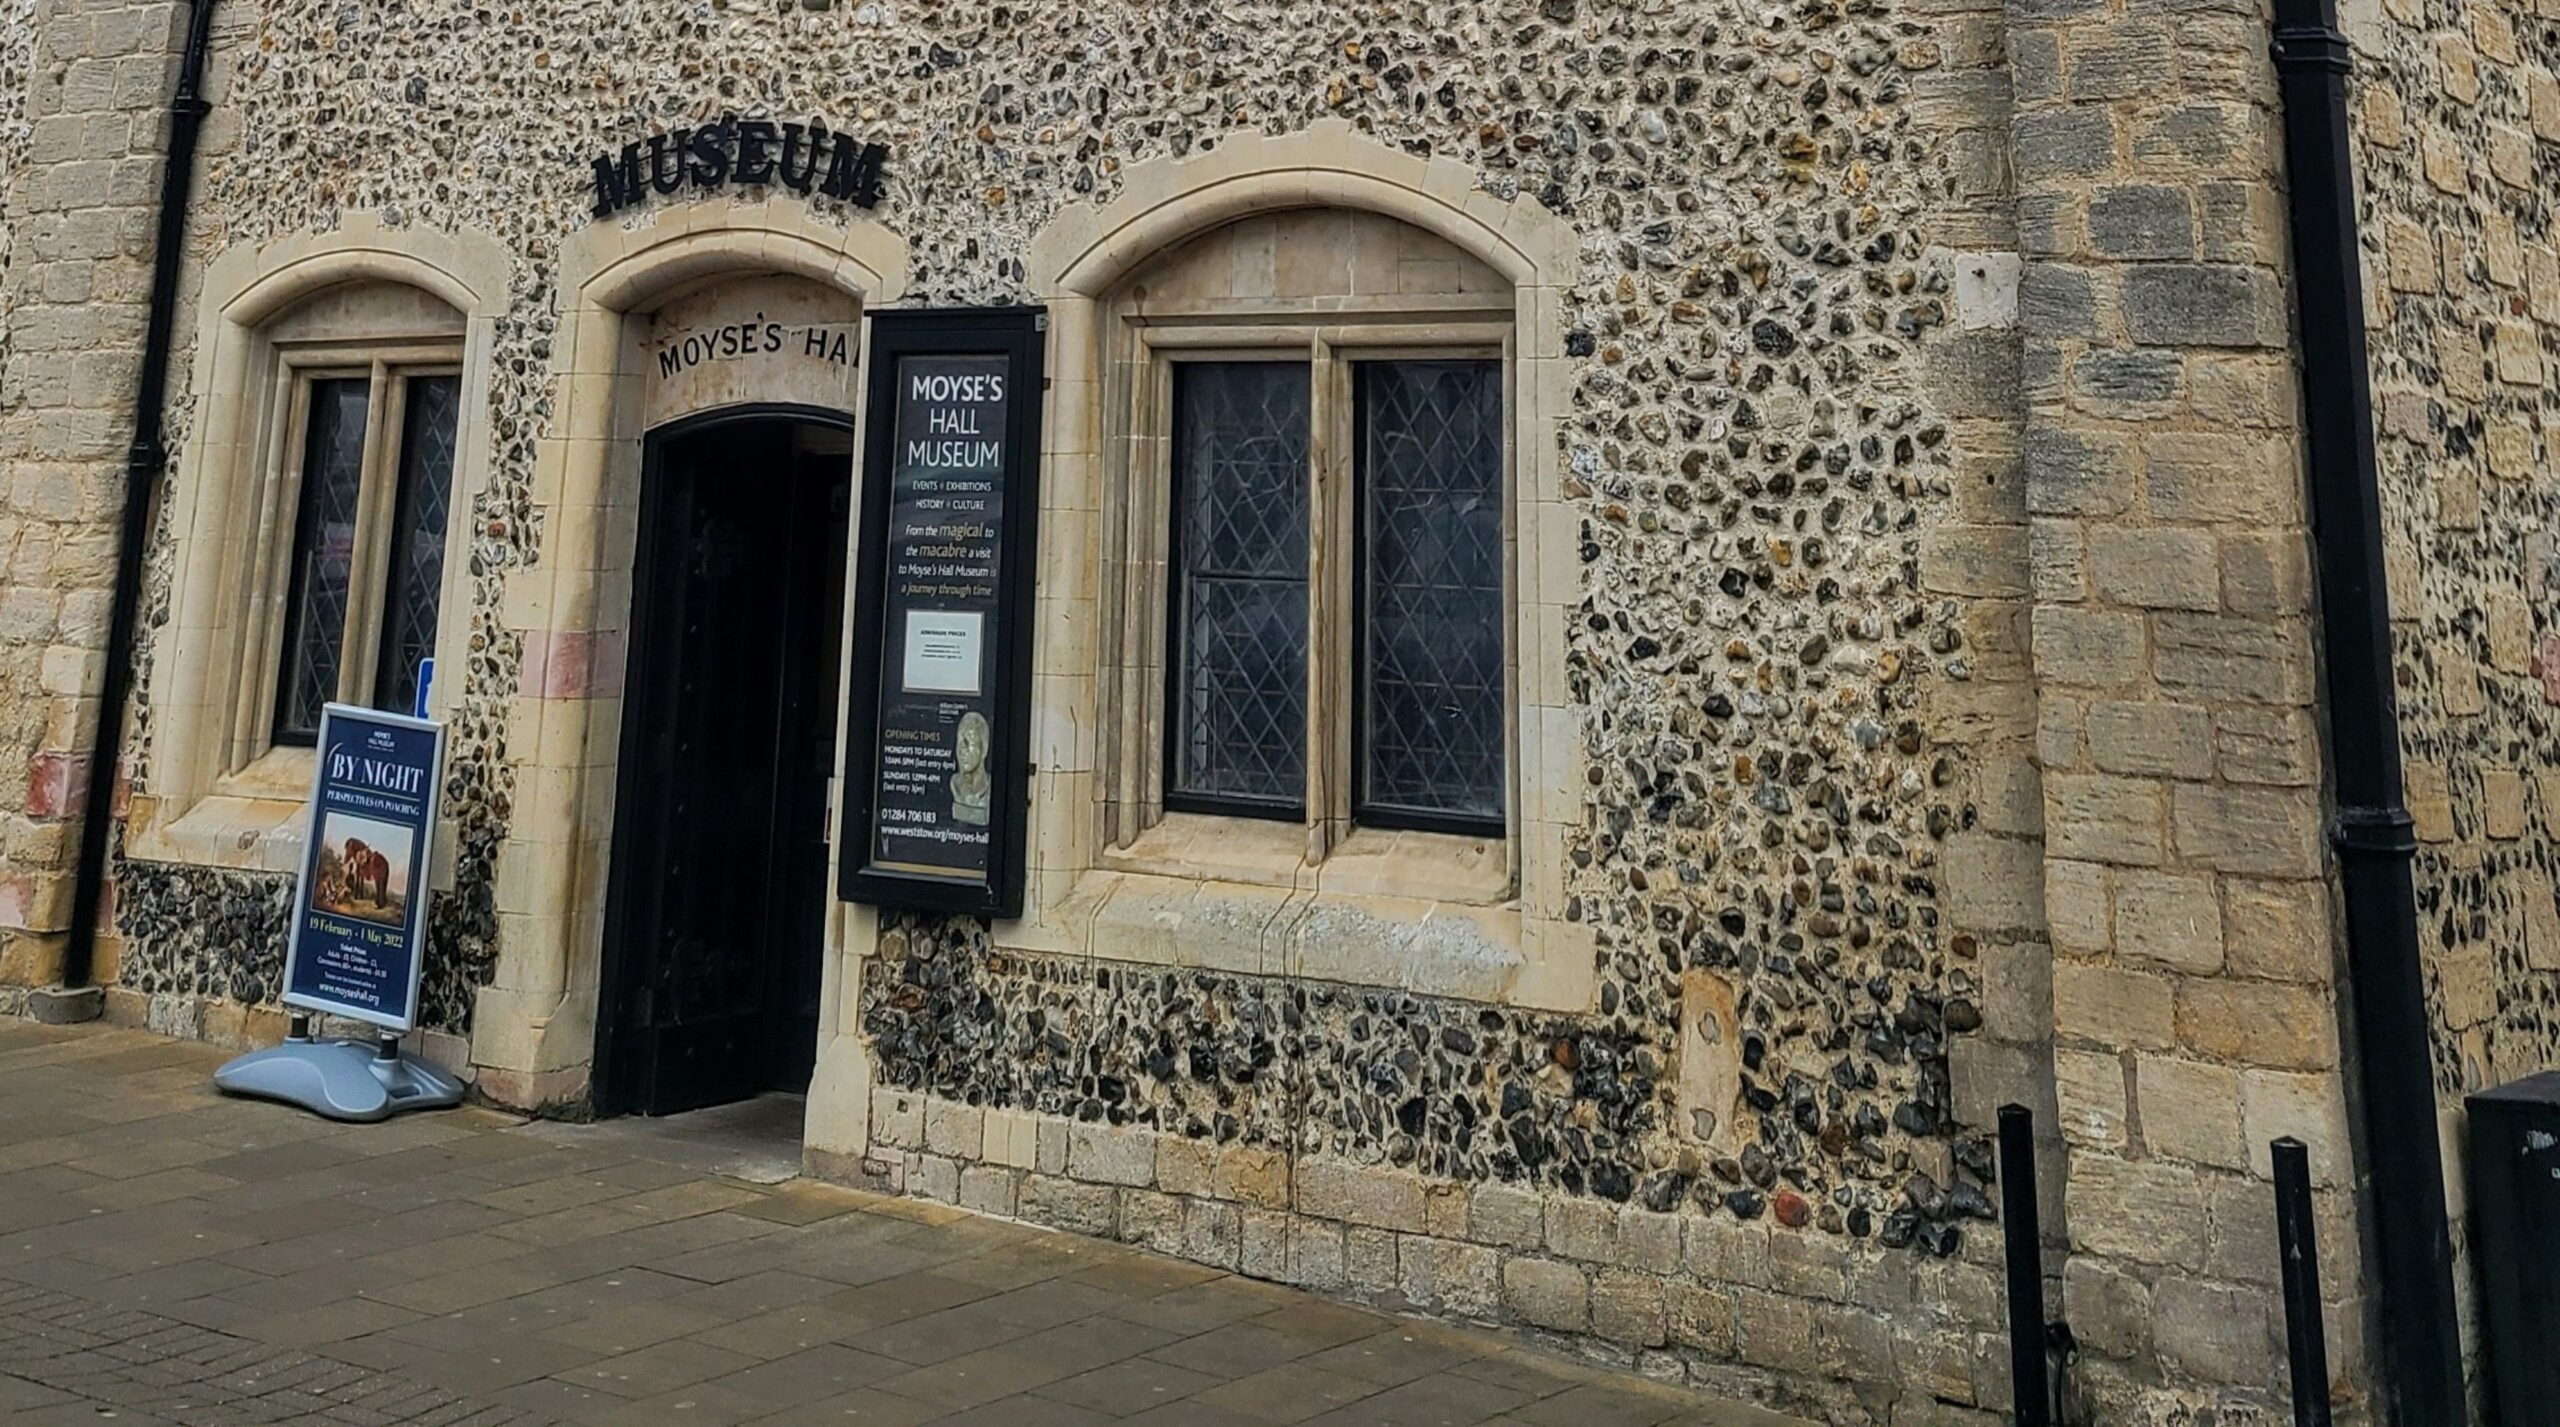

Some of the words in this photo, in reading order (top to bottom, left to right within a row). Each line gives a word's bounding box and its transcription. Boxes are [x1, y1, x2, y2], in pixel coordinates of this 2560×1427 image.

[591, 117, 890, 219] MUSEUM
[658, 312, 782, 379] MOYSE'S
[911, 373, 1003, 402] MOYSE'S
[929, 408, 980, 435] HALL
[907, 440, 999, 468] MUSEUM
[913, 481, 938, 490] EVENTS
[946, 481, 992, 491] EXHIBITIONS
[916, 499, 944, 509] HISTORY
[953, 500, 985, 510] CULTURE
[905, 524, 924, 536] From
[925, 525, 938, 536] the
[939, 522, 984, 541] magical
[985, 527, 994, 538] to
[906, 544, 918, 556] the
[919, 542, 966, 557] macabre
[968, 549, 974, 558] a
[975, 549, 992, 559] visit
[898, 564, 907, 574] to
[908, 563, 937, 578] Moyse's
[938, 564, 954, 576] Hall
[955, 565, 988, 577] Museum
[990, 567, 996, 577] is
[901, 584, 906, 593] a
[906, 582, 937, 597] journey
[939, 583, 971, 598] through
[973, 584, 992, 596] time
[885, 729, 918, 740] OPENING
[919, 731, 940, 742] TIMES
[884, 745, 913, 755] MONDAYS
[914, 747, 922, 755] TO
[923, 747, 952, 757] SATURDAY
[331, 753, 360, 781] BY
[360, 758, 424, 793] NIGHT
[883, 771, 910, 780] SUNDAYS
[327, 789, 374, 806] PERSPECTIVES
[374, 799, 384, 809] ON
[385, 801, 419, 815] POACHING
[881, 808, 906, 820] 01284
[908, 810, 936, 823] 706183
[881, 825, 989, 844] www.weststow.org/moyses-hall
[309, 917, 319, 929] 19
[320, 918, 352, 940] February
[361, 928, 365, 940] 1
[367, 928, 382, 947] May
[383, 933, 403, 948] 2022
